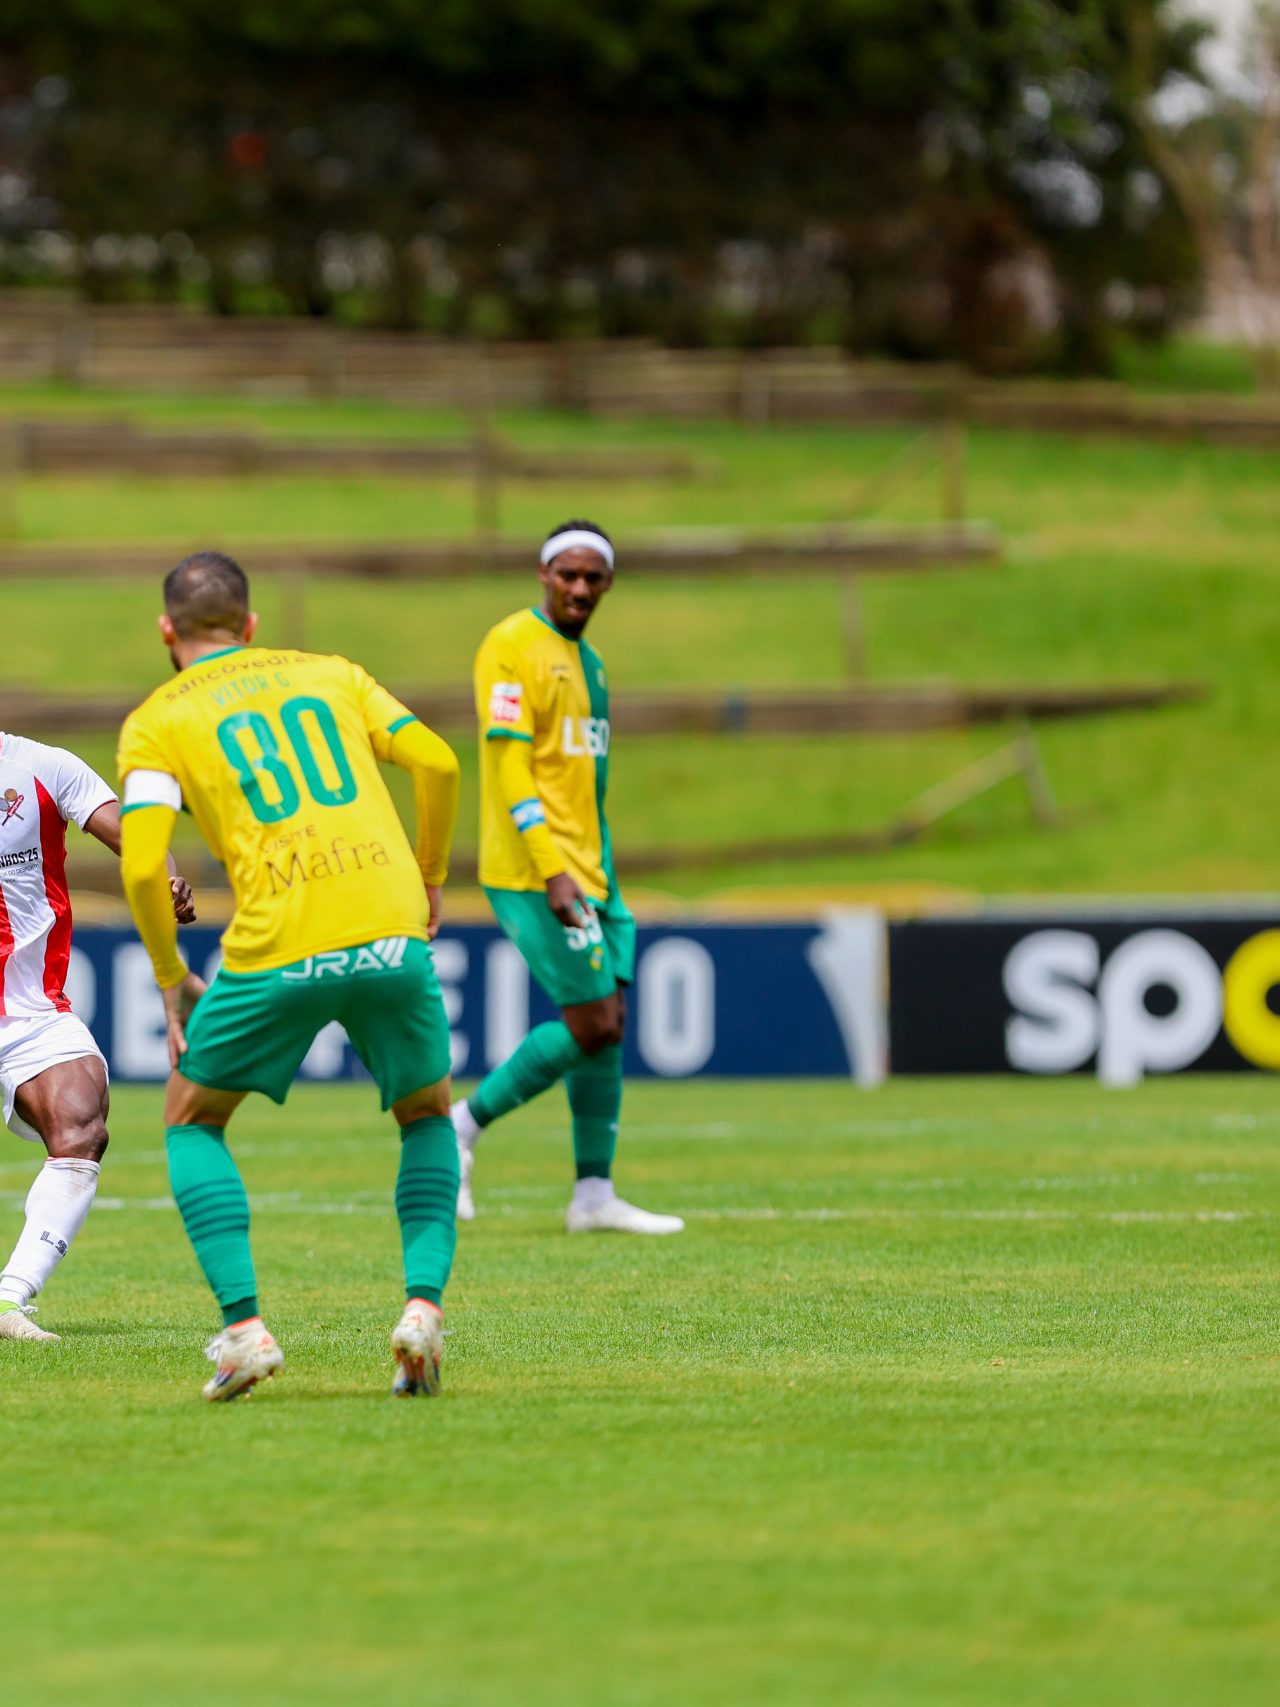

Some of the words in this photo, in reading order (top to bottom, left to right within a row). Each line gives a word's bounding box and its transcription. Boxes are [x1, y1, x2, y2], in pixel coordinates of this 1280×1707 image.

[209, 673, 270, 707] VITOR
[216, 696, 358, 823] 80
[266, 836, 391, 895] Mafra
